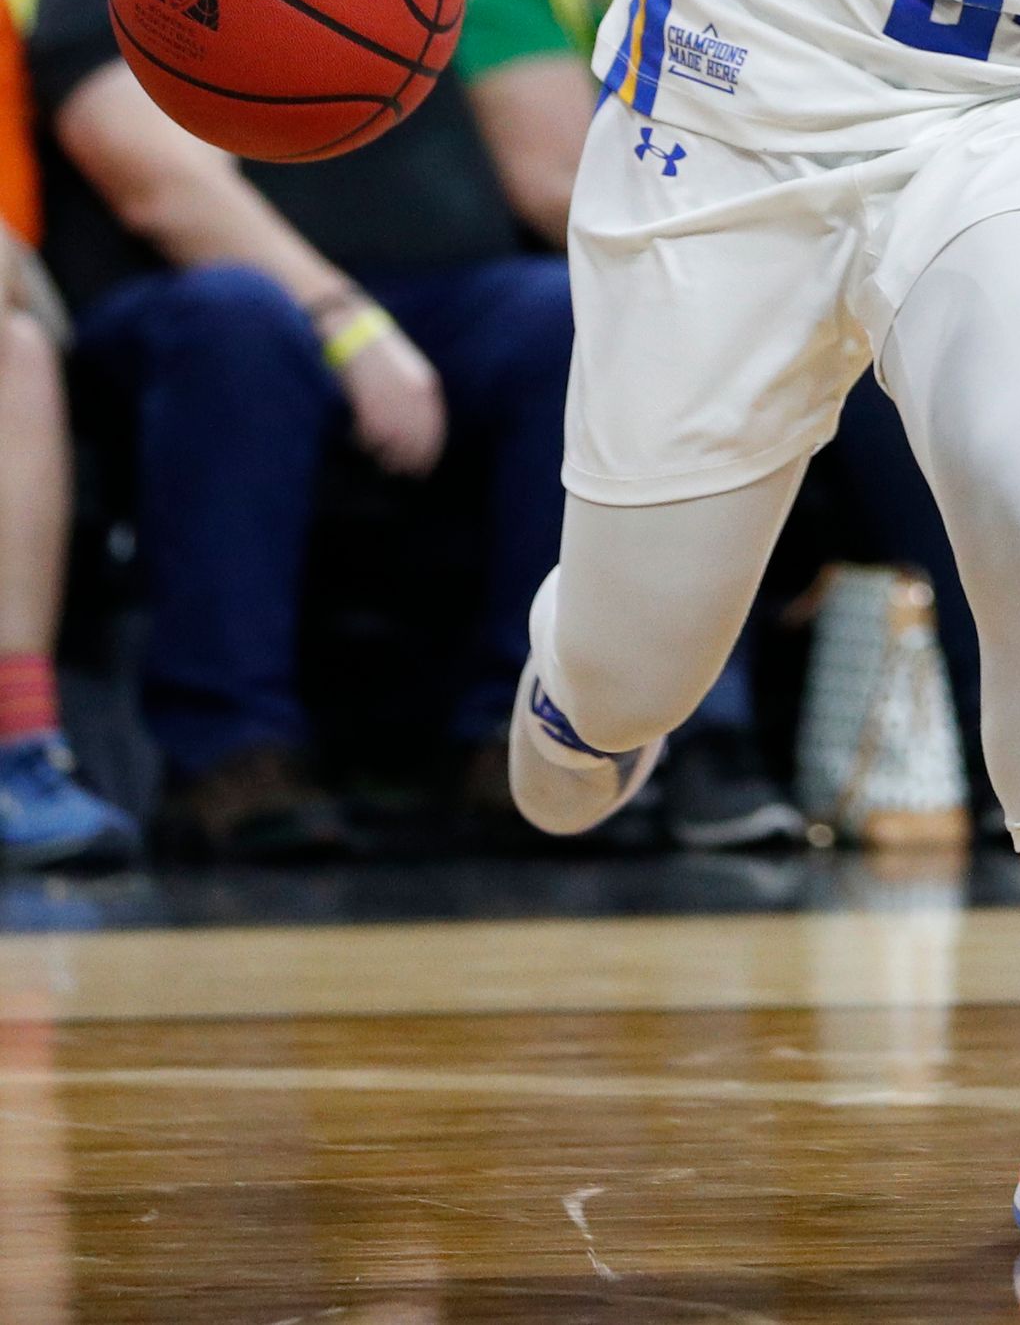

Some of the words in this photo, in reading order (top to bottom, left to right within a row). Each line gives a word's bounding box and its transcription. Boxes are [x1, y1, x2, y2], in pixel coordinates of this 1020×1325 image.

[667, 25, 748, 67] CHAMPIONS
[669, 45, 703, 73] MADE
[706, 58, 740, 85] HERE
